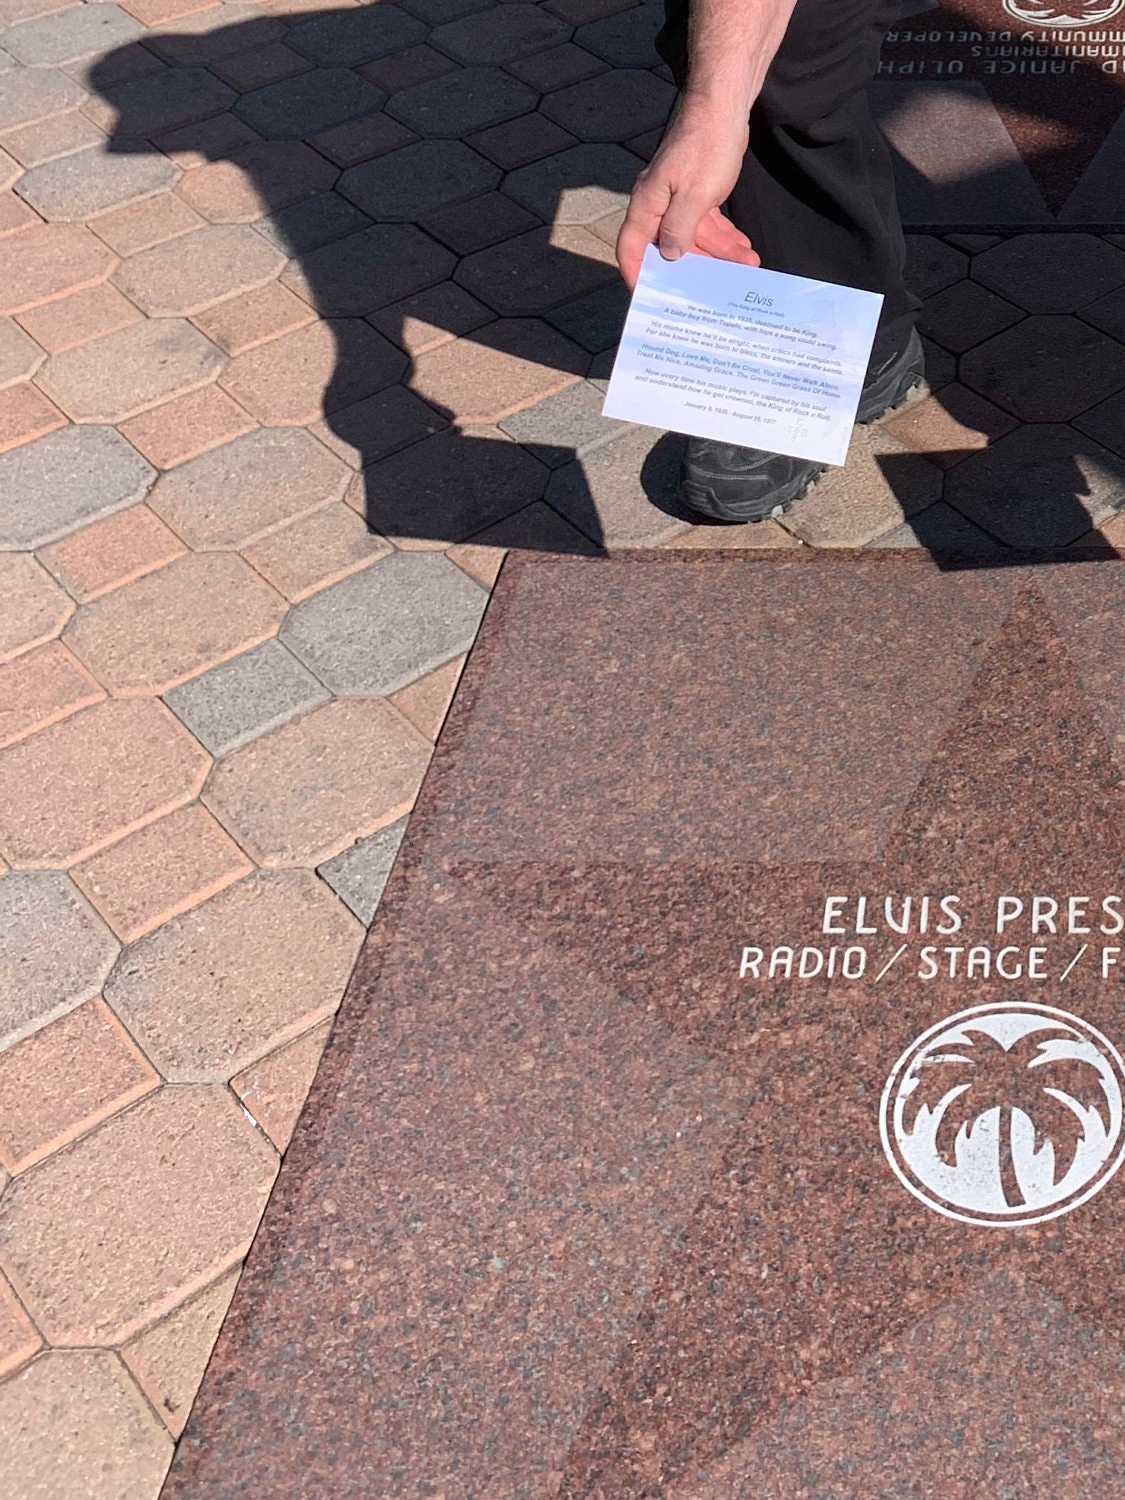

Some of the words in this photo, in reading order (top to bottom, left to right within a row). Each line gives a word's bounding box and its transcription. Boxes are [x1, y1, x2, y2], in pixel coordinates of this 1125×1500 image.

[886, 31, 1012, 42] DEVELOPER
[984, 59, 1082, 74] JANICE
[744, 291, 773, 307] Elvis
[822, 896, 962, 934] ELVIS
[739, 946, 867, 979] RADIO
[918, 946, 1048, 979] STAGE
